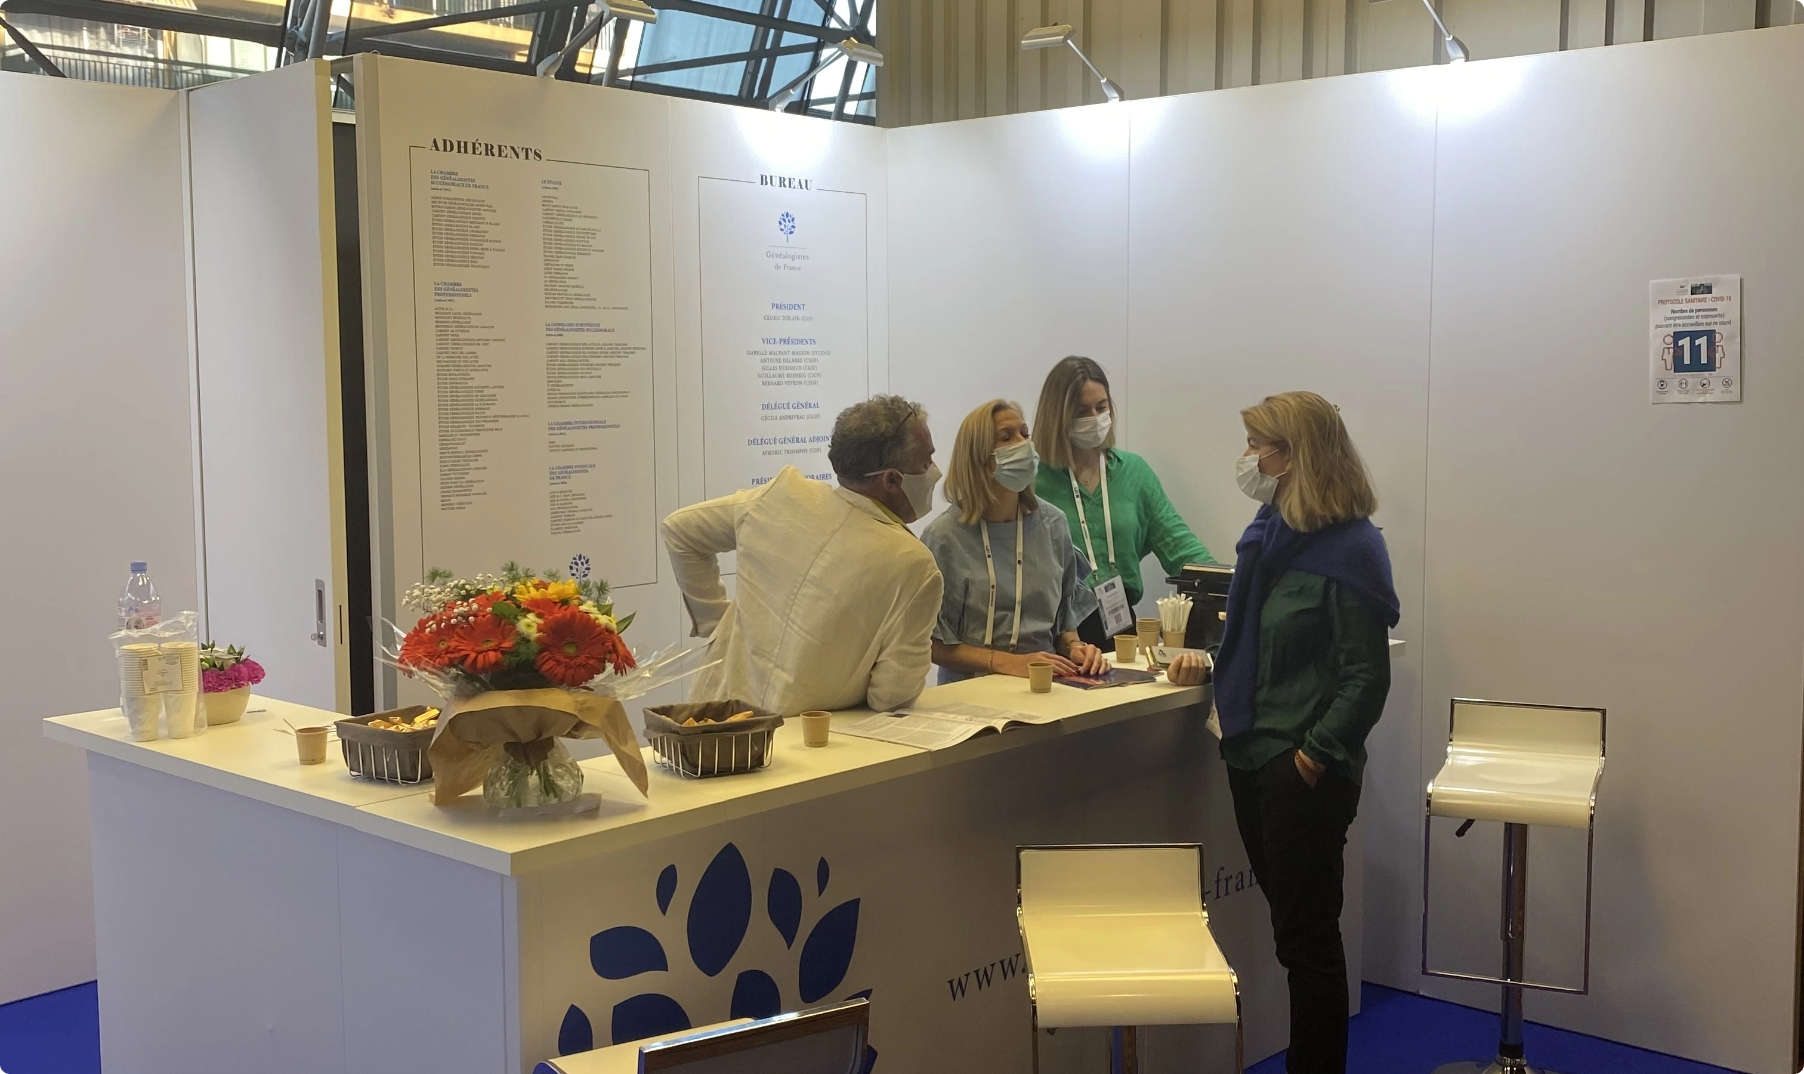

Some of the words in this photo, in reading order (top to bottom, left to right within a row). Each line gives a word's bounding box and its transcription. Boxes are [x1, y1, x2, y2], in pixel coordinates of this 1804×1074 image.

[430, 137, 543, 161] ADHÉRENTS
[760, 174, 813, 190] BUREAU
[771, 302, 806, 311] PRÉSIDENT
[1678, 335, 1708, 365] 11
[761, 402, 790, 411] DÉLÉGUÉ
[791, 401, 820, 410] GÉNÉRAL
[747, 437, 777, 446] DÉLÉGUÉ
[778, 435, 808, 445] GÉNÉRAL
[808, 435, 831, 443] ADJOIN
